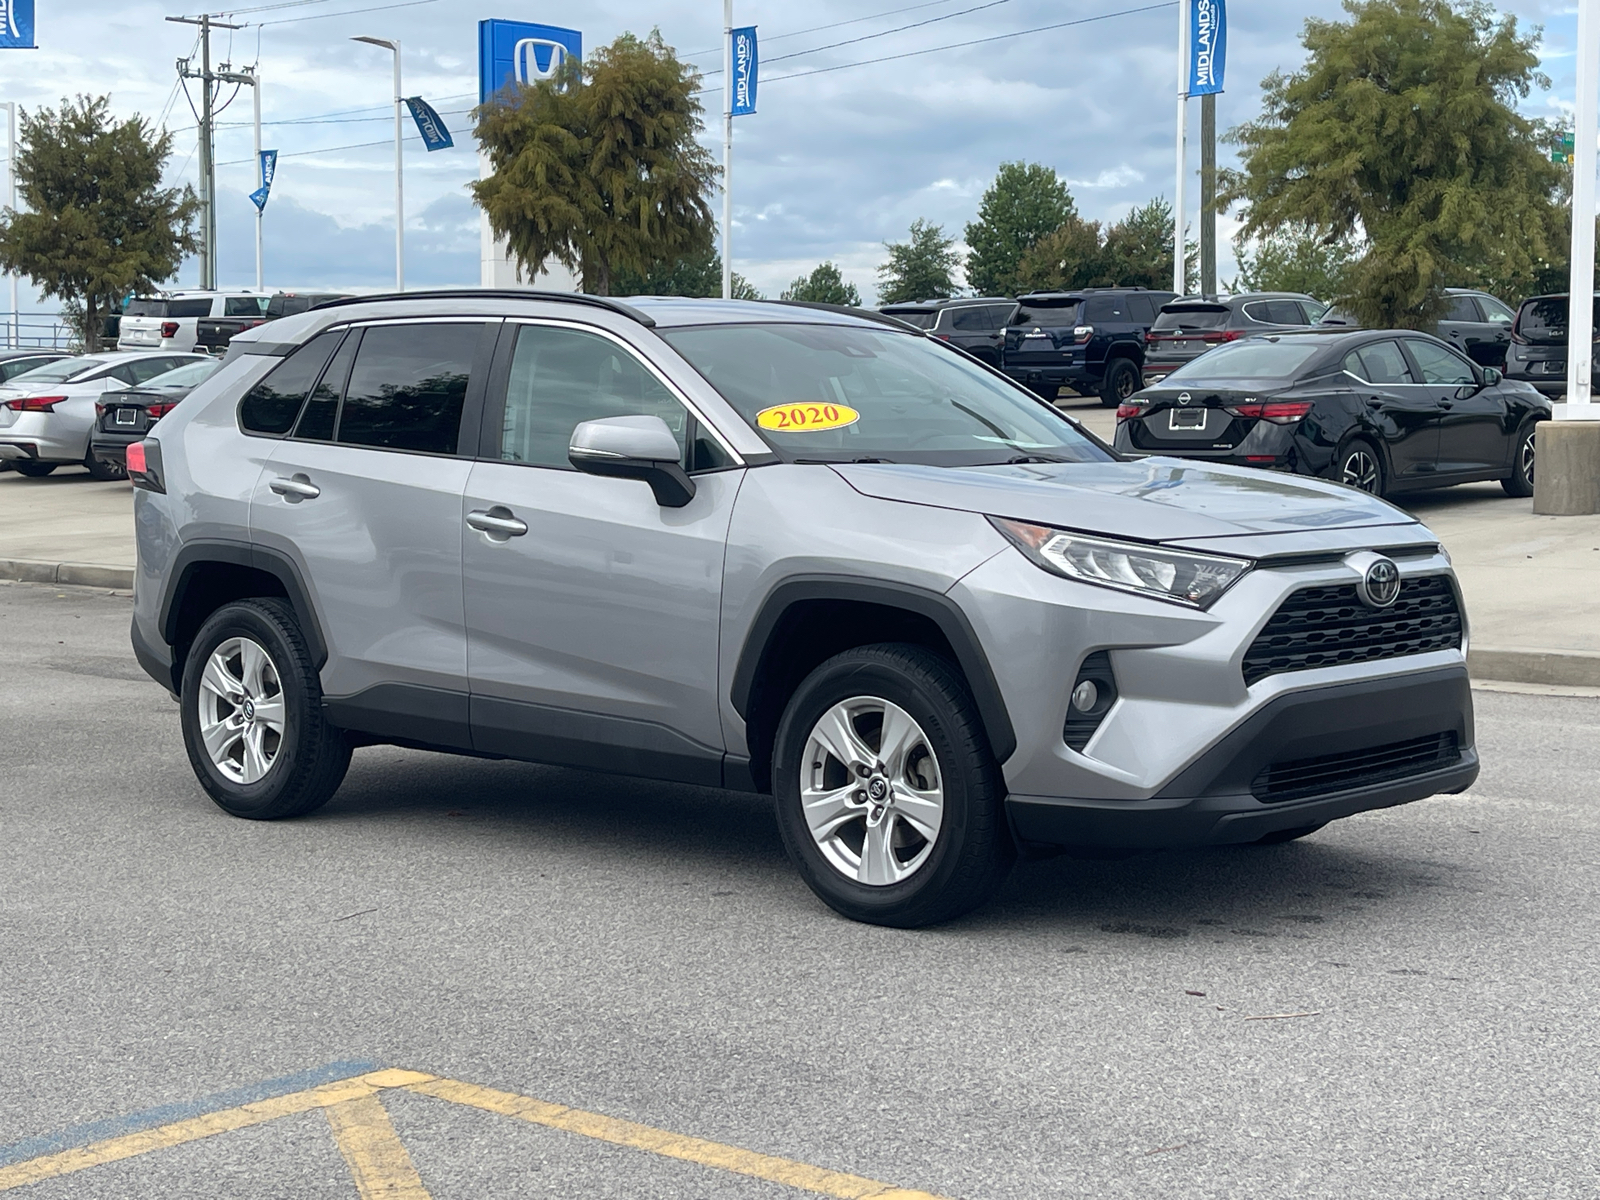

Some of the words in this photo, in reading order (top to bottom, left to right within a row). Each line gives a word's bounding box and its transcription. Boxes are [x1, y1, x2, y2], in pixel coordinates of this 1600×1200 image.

[737, 34, 746, 107] MIDLANDS
[1197, 0, 1210, 85] MIDLANDS
[410, 100, 440, 143] MIDLAN
[773, 405, 839, 428] 2020
